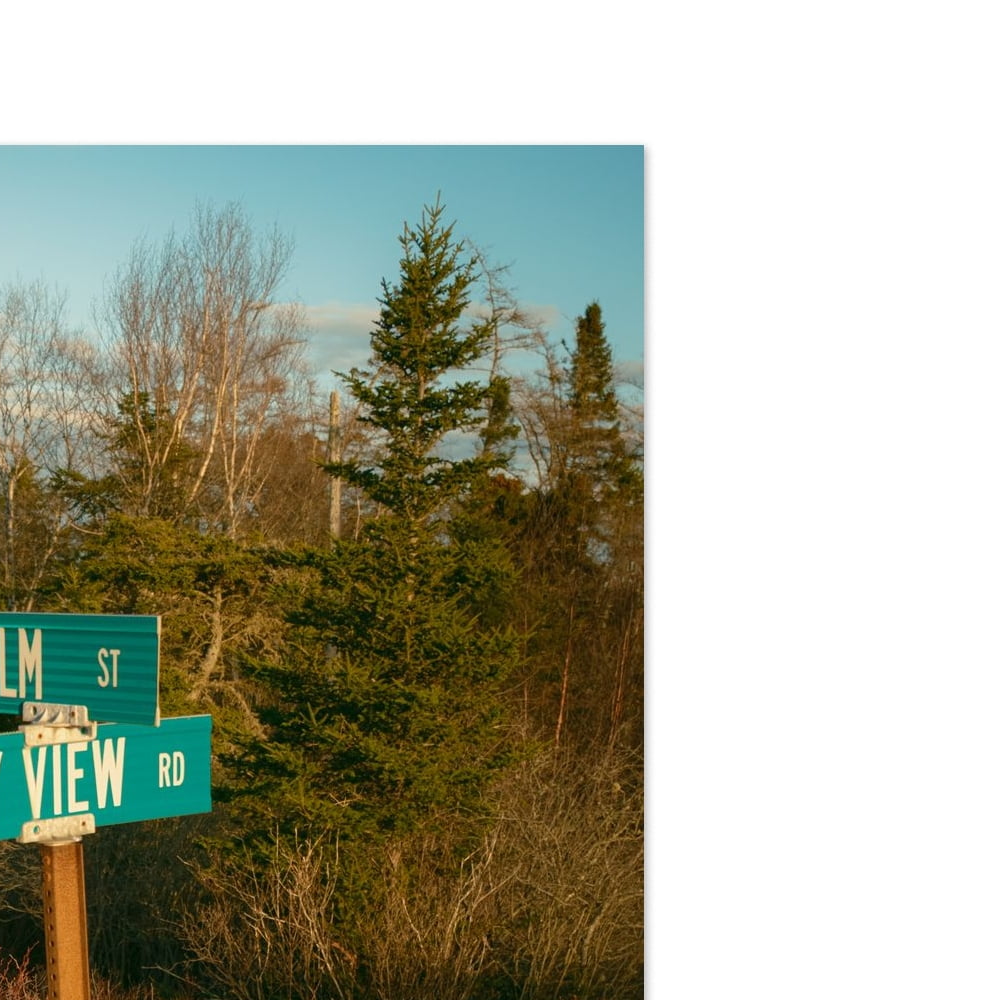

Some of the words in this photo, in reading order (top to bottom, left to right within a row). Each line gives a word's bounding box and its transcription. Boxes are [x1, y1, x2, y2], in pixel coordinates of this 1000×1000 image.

[97, 648, 121, 688] ST
[22, 737, 126, 819] VIEW
[158, 751, 185, 788] RD
